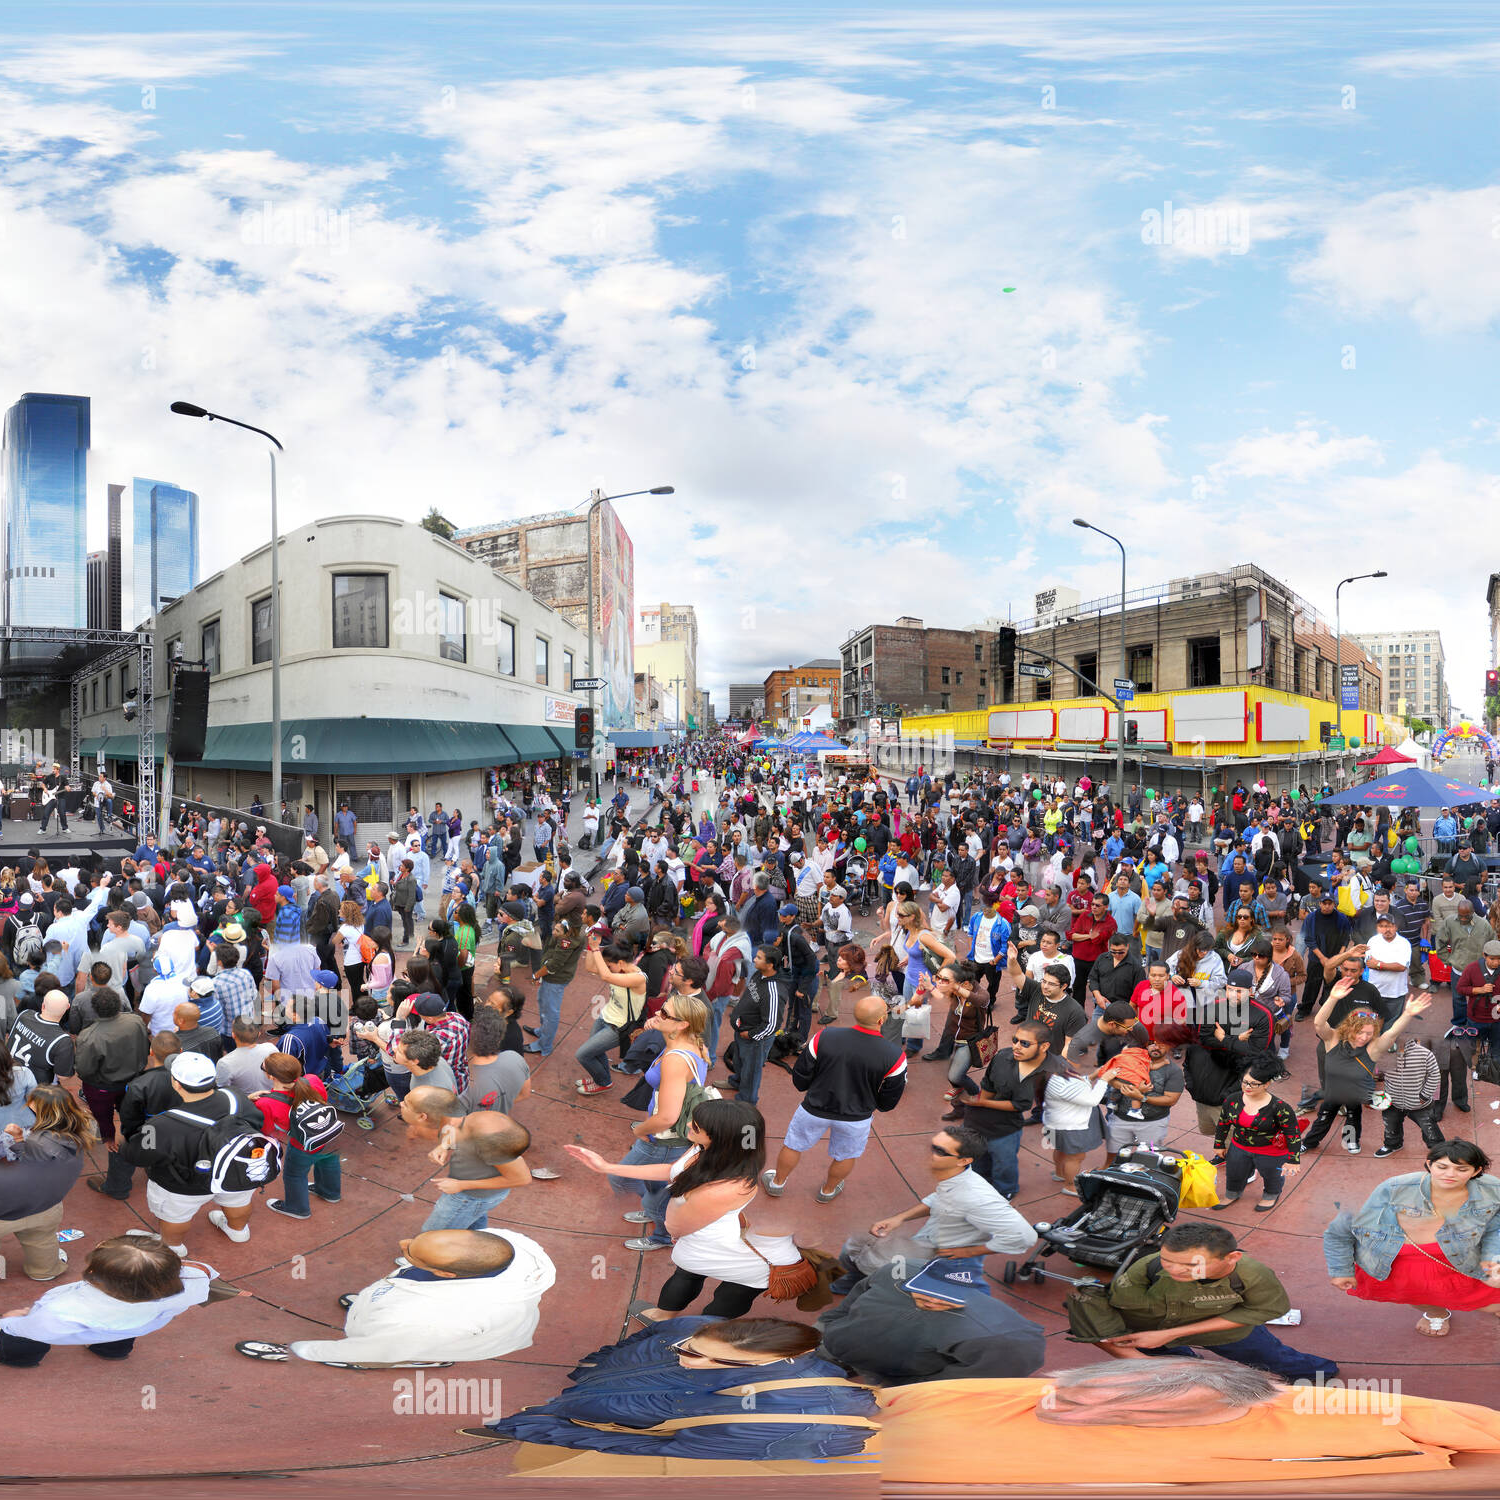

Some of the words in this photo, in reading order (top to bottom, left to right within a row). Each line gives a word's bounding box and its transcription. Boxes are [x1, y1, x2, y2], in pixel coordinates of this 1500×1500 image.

[1035, 589, 1057, 600] WELLS
[1035, 597, 1056, 608] FARGO
[1037, 606, 1055, 614] BANK
[1020, 664, 1031, 673] ONE
[1033, 667, 1045, 675] WAY
[15, 1021, 46, 1047] NOWITZKI
